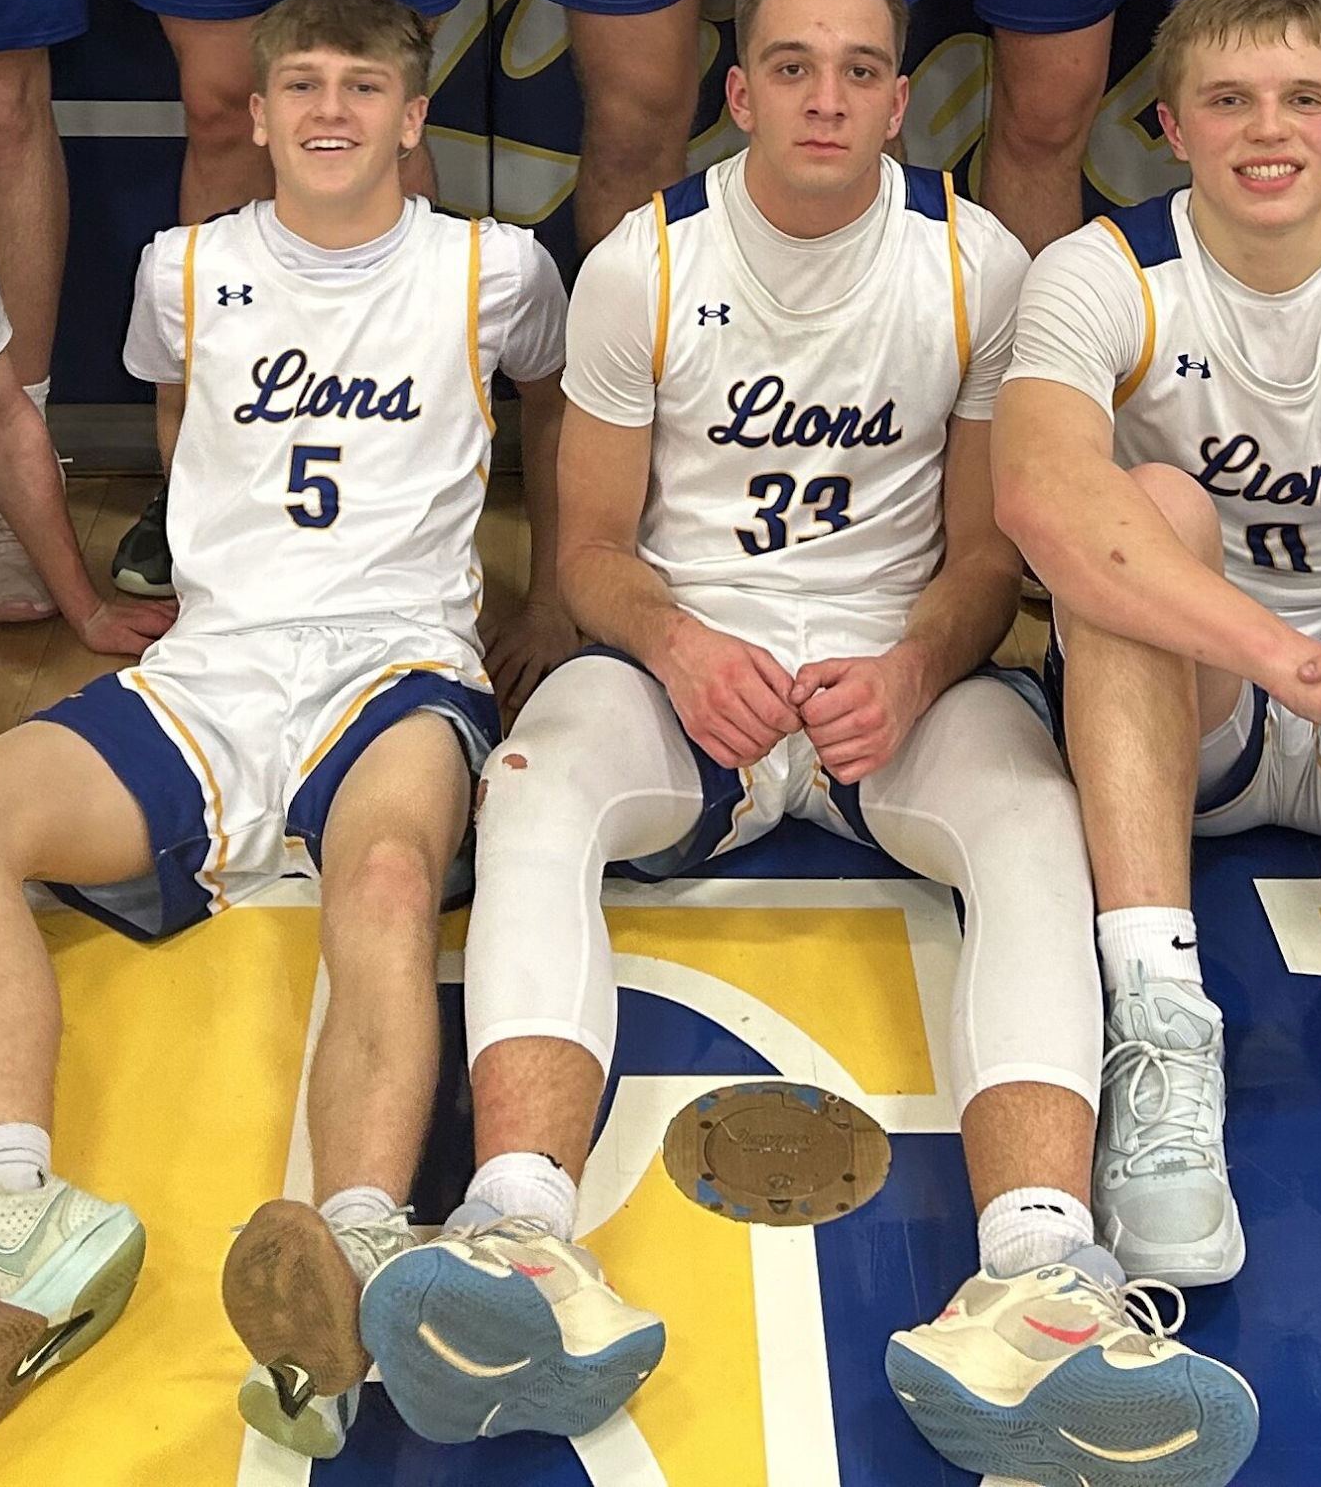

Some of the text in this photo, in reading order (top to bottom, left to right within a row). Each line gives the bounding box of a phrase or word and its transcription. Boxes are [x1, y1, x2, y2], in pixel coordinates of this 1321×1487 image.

[234, 349, 421, 424] Lions
[708, 376, 903, 449] Lions
[284, 444, 342, 530] 5
[733, 471, 854, 557] 33
